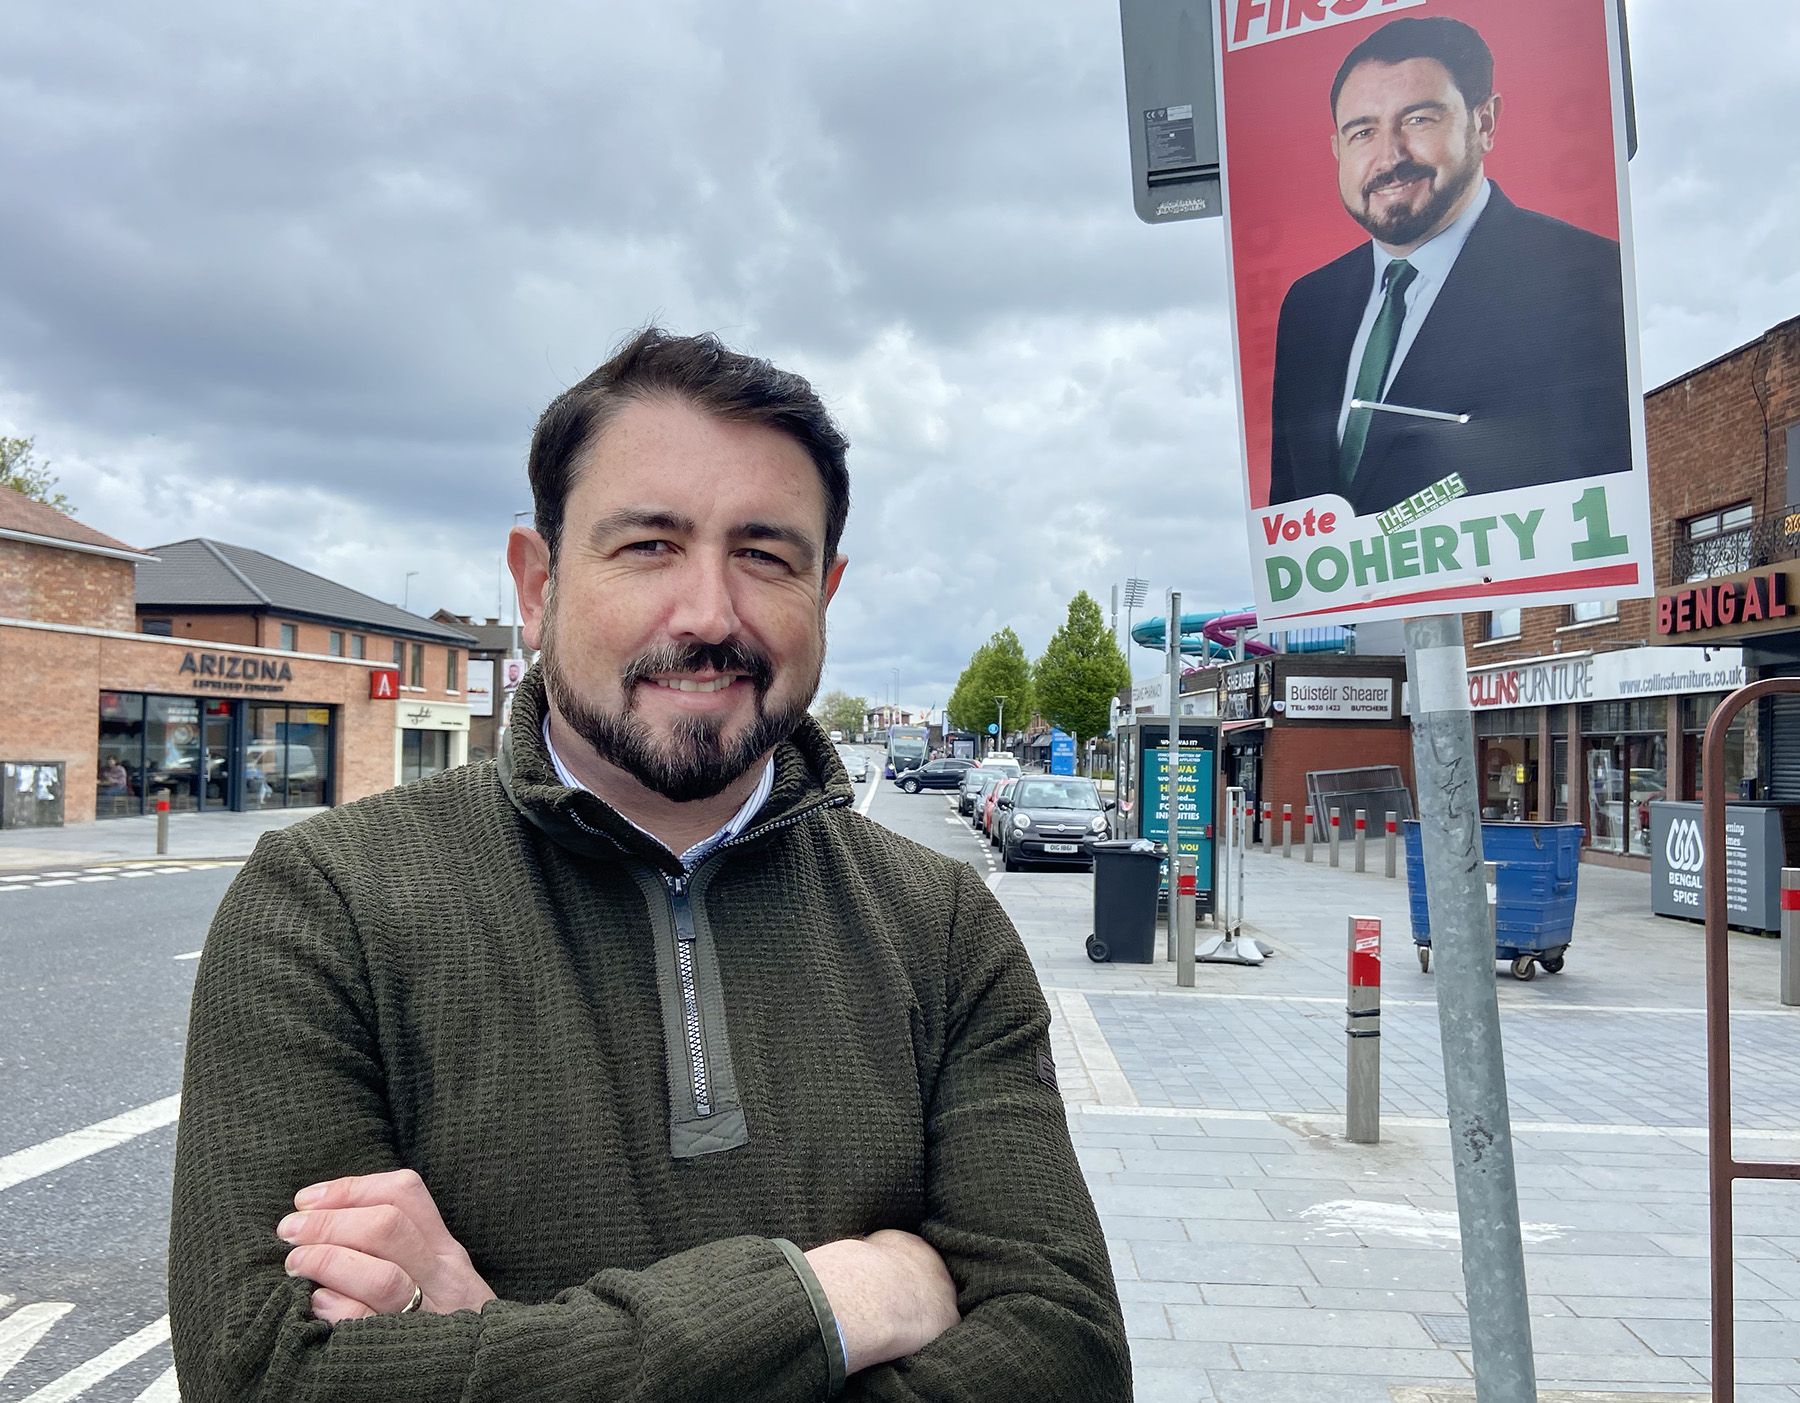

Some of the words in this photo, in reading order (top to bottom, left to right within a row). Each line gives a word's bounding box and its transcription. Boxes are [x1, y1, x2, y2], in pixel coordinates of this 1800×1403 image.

[1376, 500, 1413, 531] THE
[1407, 472, 1465, 513] CELTS
[1262, 507, 1336, 546] Vote
[1265, 508, 1545, 602] DOHERTY
[1571, 486, 1629, 561] 1
[1656, 571, 1787, 636] BENGAL
[179, 652, 293, 682] ARIZONA
[377, 673, 391, 697] A
[1227, 671, 1255, 691] SHEARER
[1619, 664, 1742, 695] www.collinsfurniture.co.uk
[1291, 685, 1337, 701] Búistéir
[1342, 685, 1388, 701] Shearer
[1350, 704, 1388, 712] BUTCHERS
[1178, 765, 1197, 773] WAS
[1177, 785, 1196, 793] WAS
[1178, 803, 1197, 811] OUR
[1180, 843, 1199, 852] YOU
[1668, 872, 1703, 889] BENGAL
[1673, 889, 1699, 906] SPICE
